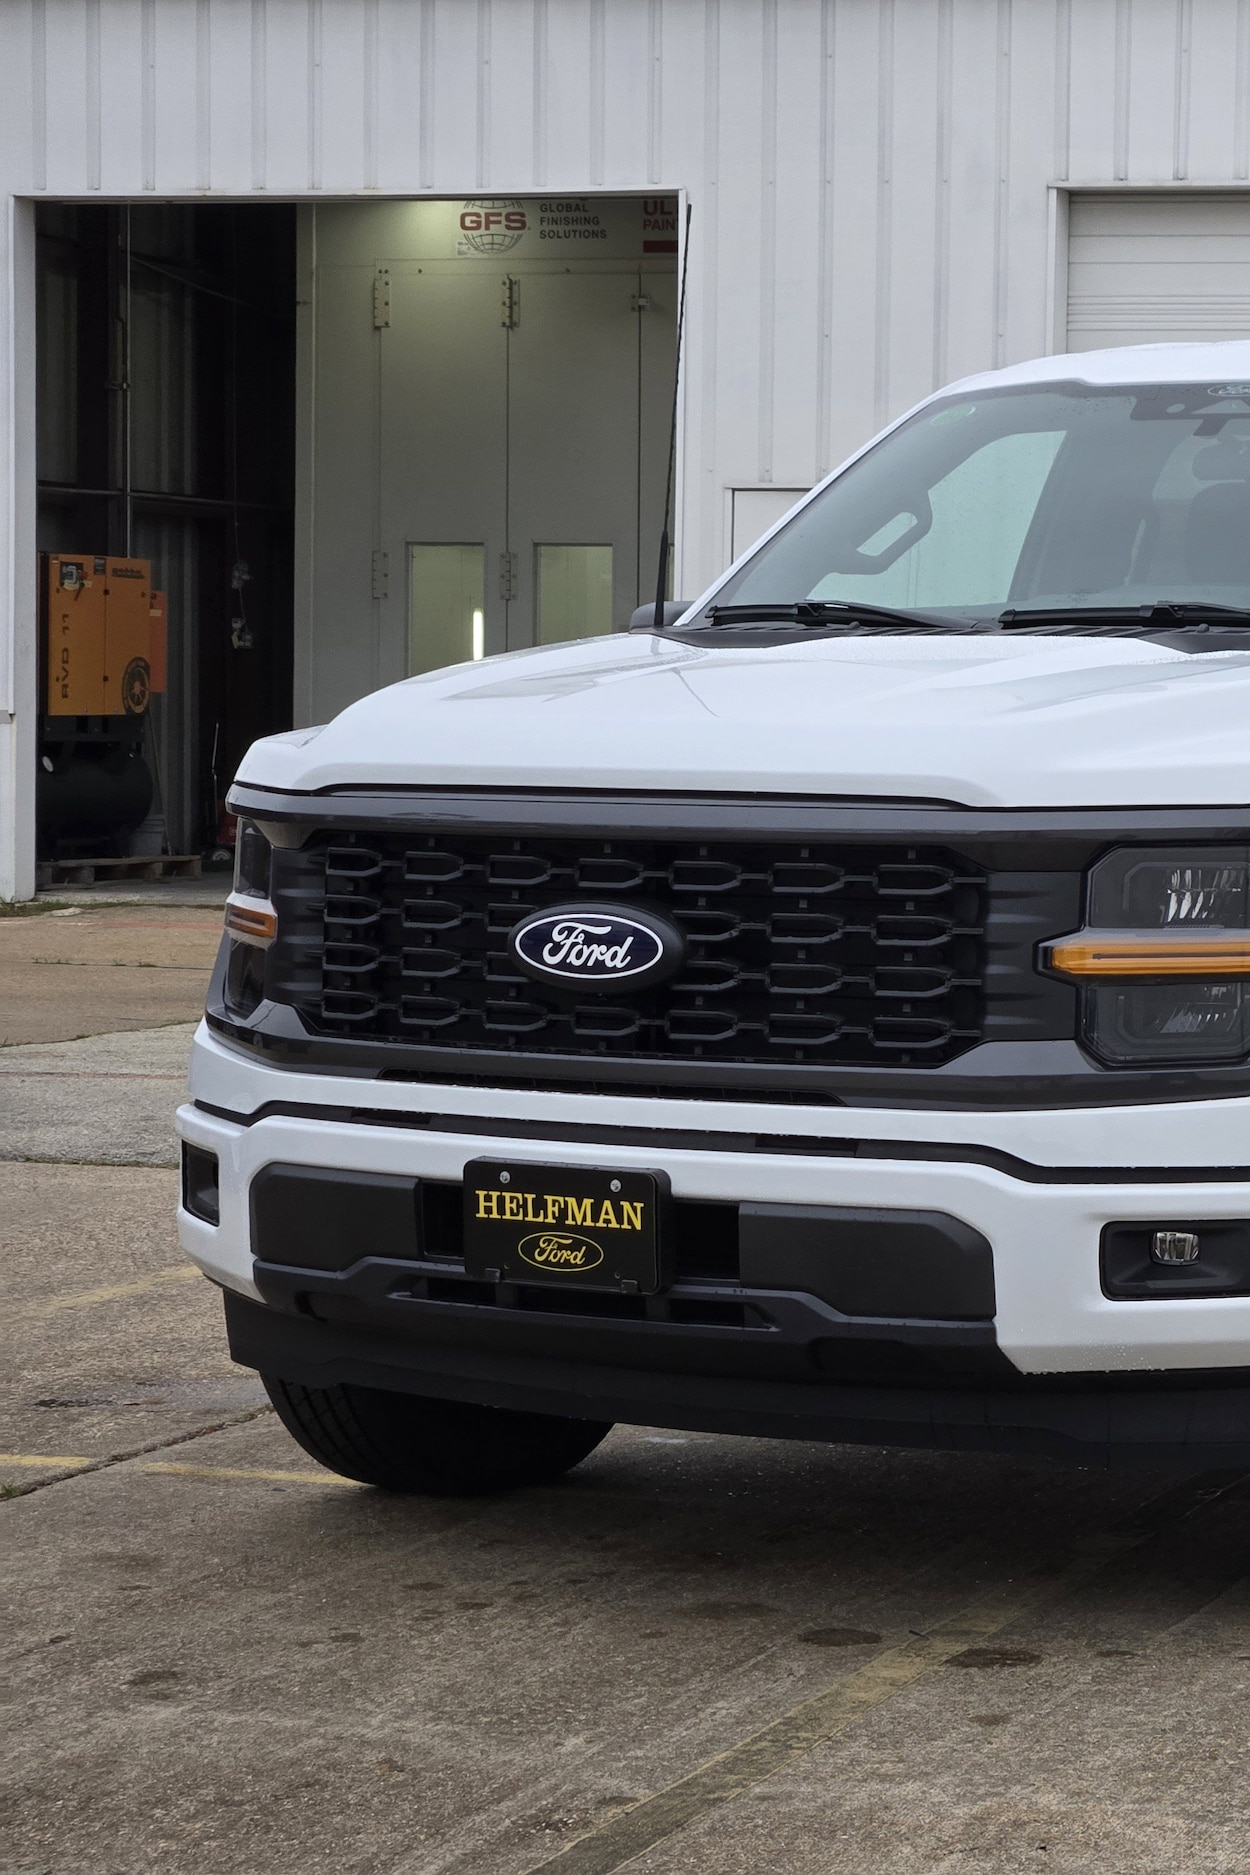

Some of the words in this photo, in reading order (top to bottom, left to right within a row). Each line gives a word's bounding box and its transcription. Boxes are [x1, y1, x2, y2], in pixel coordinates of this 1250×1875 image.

[539, 203, 589, 213] GLOBAL
[643, 200, 673, 216] UL
[460, 211, 527, 231] GFS
[539, 216, 600, 226] FINISHING
[643, 219, 677, 231] PAIN
[539, 229, 608, 240] SOLUTIONS
[542, 921, 635, 969] Ford
[475, 1189, 645, 1231] HELFMAN
[534, 1235, 587, 1265] Ford
